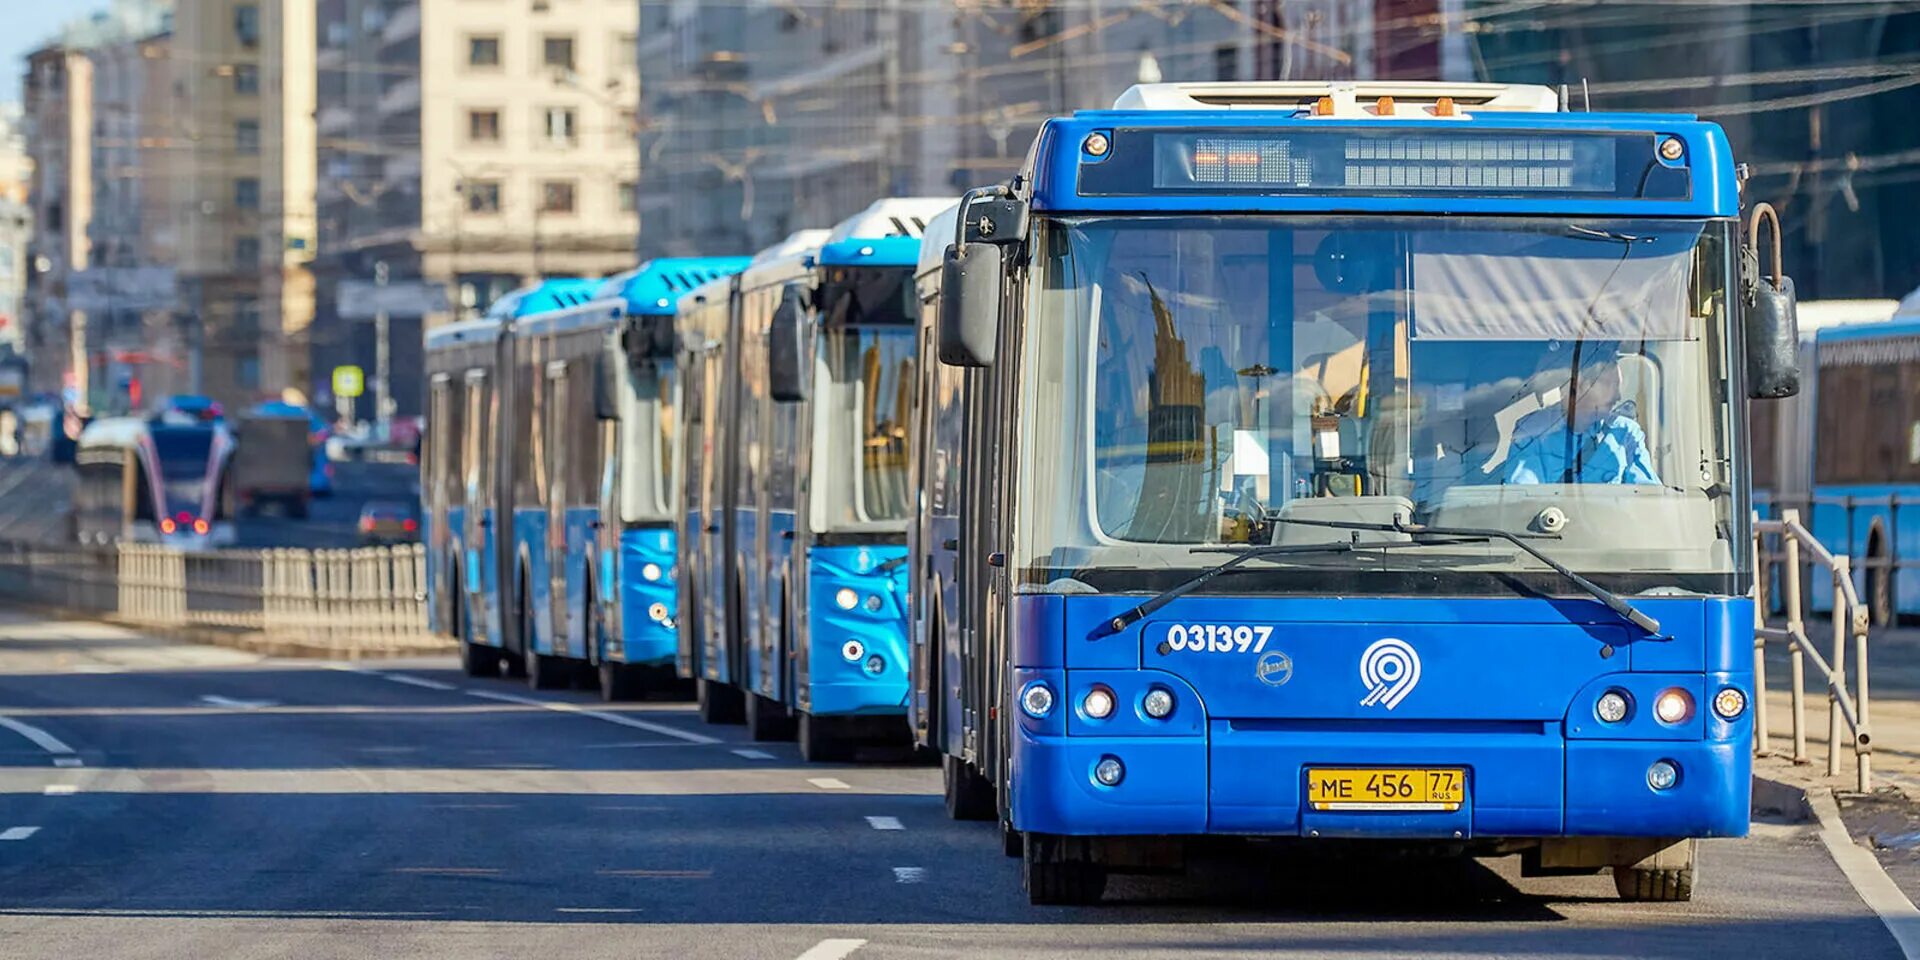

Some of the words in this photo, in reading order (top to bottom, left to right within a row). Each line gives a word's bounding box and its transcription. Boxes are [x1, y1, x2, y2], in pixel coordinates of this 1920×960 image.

[1167, 624, 1274, 653] 031397
[1365, 774, 1414, 798] 456
[1429, 773, 1454, 791] 77
[1431, 792, 1451, 800] RUS
